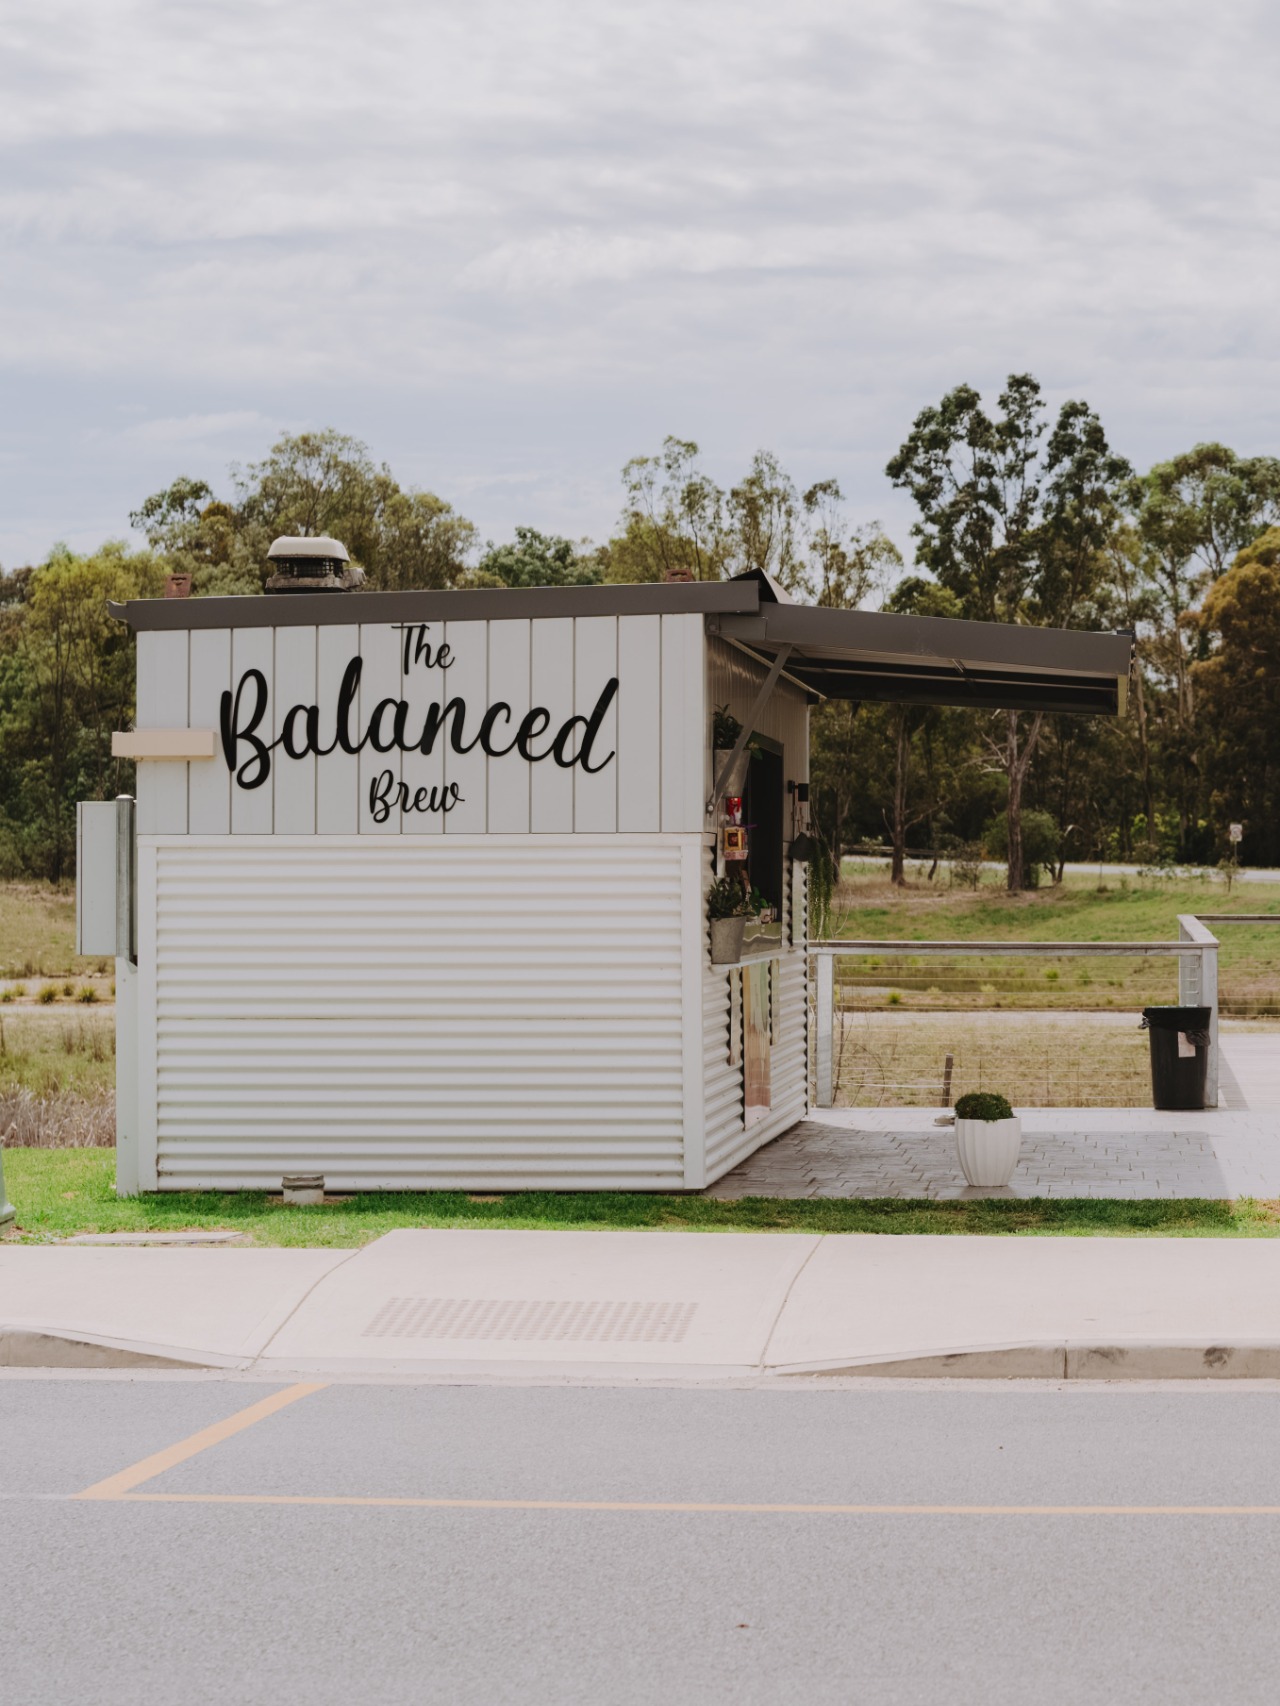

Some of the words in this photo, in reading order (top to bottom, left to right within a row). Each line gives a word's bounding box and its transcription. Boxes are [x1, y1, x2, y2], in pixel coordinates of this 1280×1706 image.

[391, 623, 456, 676] The
[219, 655, 620, 790] Balanced
[369, 769, 466, 824] Brew
